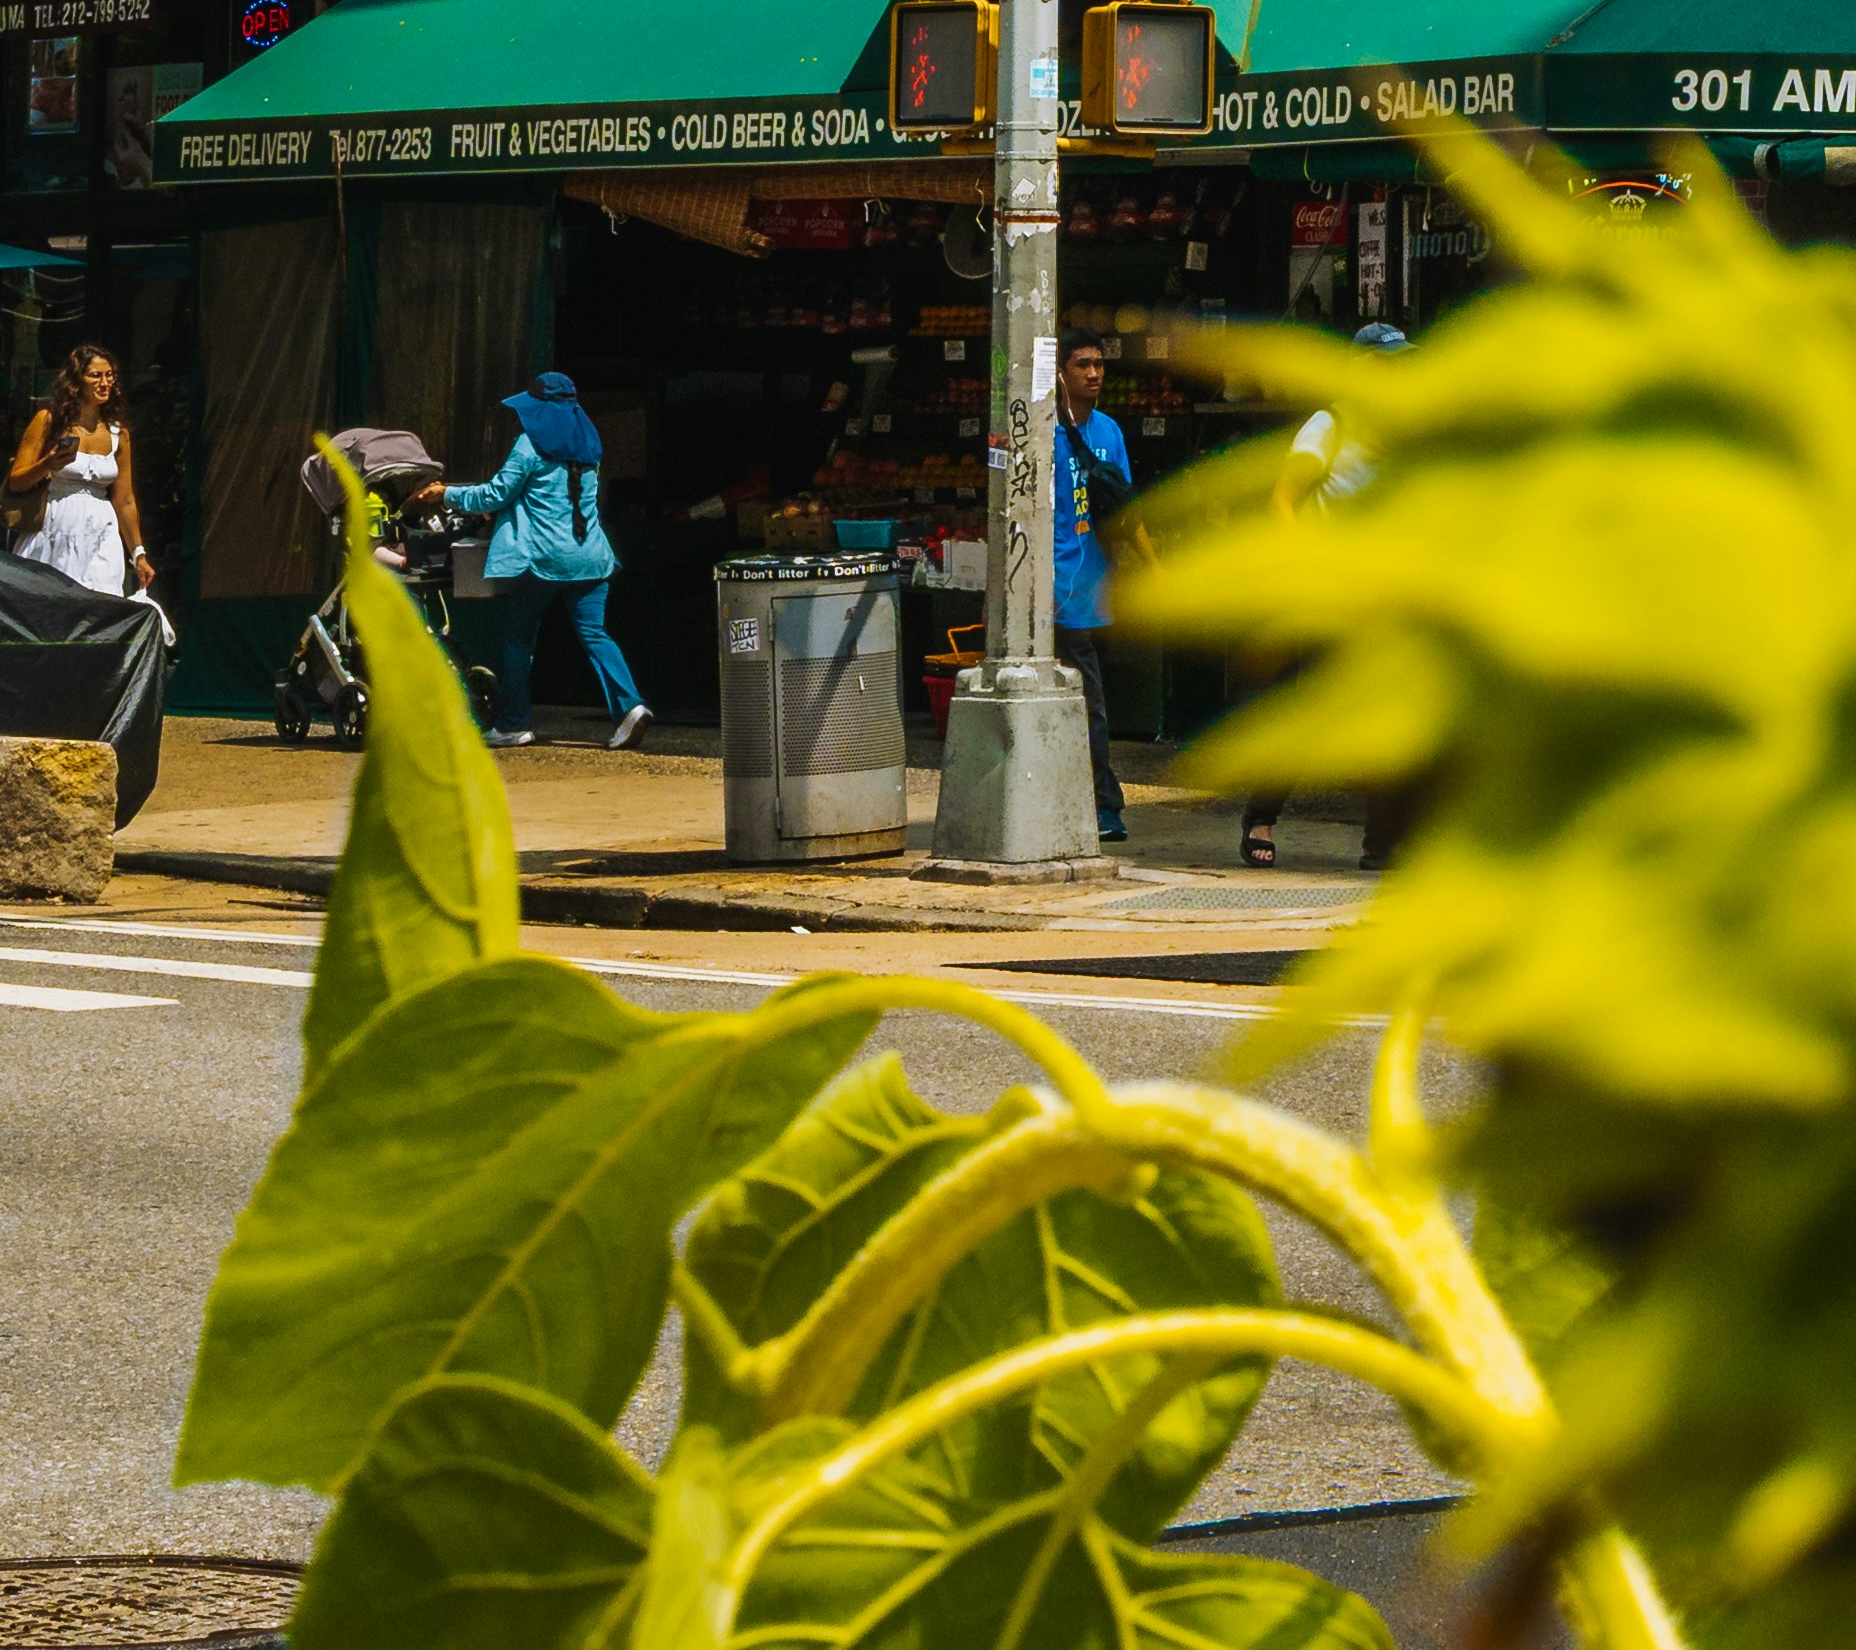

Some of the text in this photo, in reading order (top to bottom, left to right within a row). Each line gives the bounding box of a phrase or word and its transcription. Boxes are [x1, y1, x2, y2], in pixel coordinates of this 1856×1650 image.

[241, 7, 289, 38] OPEN
[1263, 91, 1279, 130] &
[1285, 85, 1351, 129] COLD
[1376, 77, 1457, 123] SALAD
[1463, 73, 1515, 116] BAR
[1671, 68, 1752, 112] 301
[180, 135, 225, 168] FREE
[228, 131, 312, 167] DELIVERY
[450, 123, 506, 158] FRUIT
[509, 123, 522, 157] &
[527, 116, 651, 155] VEGETABLES
[671, 114, 727, 151] COLD
[732, 112, 786, 148] BEER
[791, 111, 806, 147] &
[811, 108, 870, 147] SODA
[743, 569, 809, 580] Don't litter
[834, 563, 866, 576] Don't
